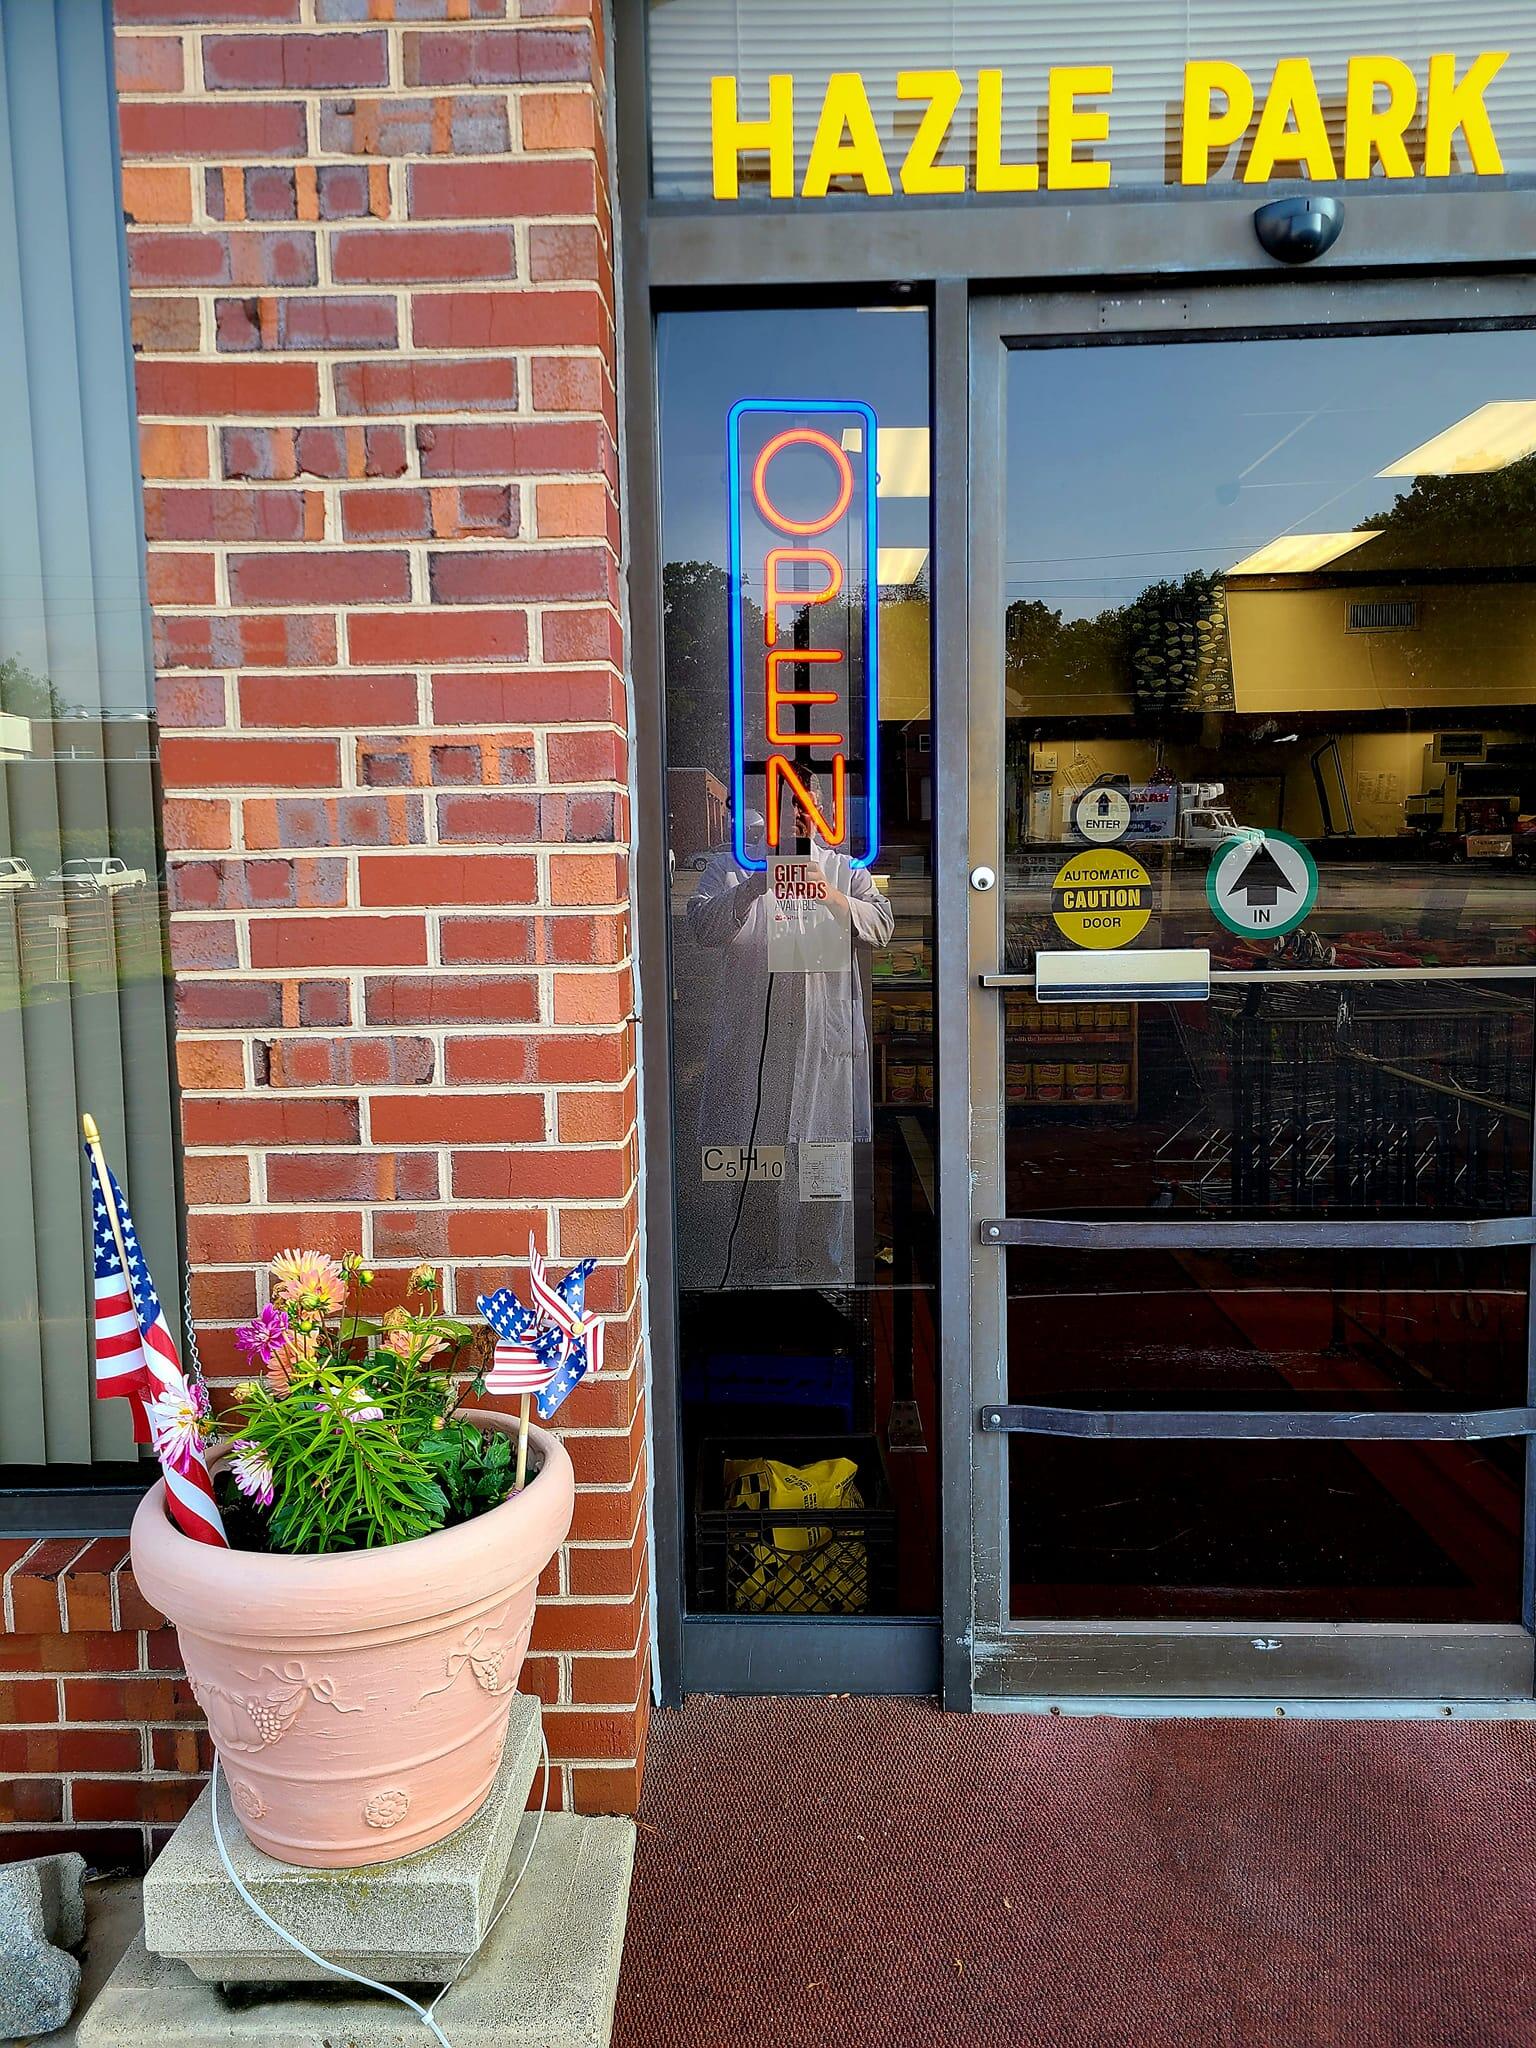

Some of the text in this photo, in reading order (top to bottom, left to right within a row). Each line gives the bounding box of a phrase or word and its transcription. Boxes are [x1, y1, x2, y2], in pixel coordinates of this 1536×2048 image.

[711, 52, 1510, 199] HAZLE PARK
[752, 427, 855, 849] OPEN
[1086, 819, 1121, 829] ENTER
[774, 864, 808, 882] GIFT
[1063, 868, 1140, 882] AUTOMATIC
[774, 881, 827, 900] CARDS
[1063, 888, 1141, 910] CAUTION
[1082, 917, 1122, 929] DOOR
[1253, 909, 1271, 923] IN
